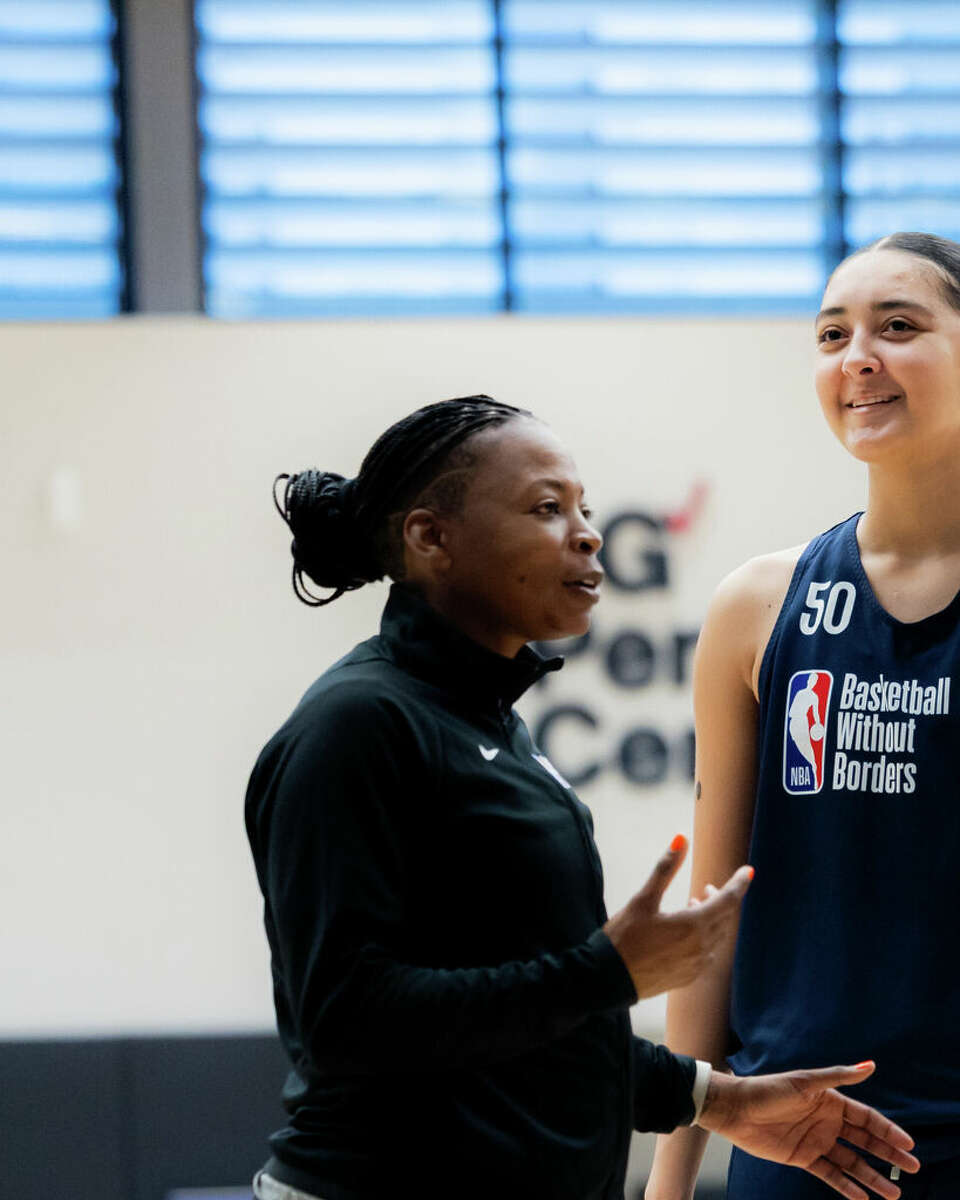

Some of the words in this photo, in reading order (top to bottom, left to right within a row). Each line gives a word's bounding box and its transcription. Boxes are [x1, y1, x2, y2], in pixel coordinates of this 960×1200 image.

[799, 580, 857, 636] 50
[839, 673, 951, 716] Basketball
[836, 711, 916, 753] Without
[790, 766, 811, 787] NBA
[831, 752, 918, 794] Borders
